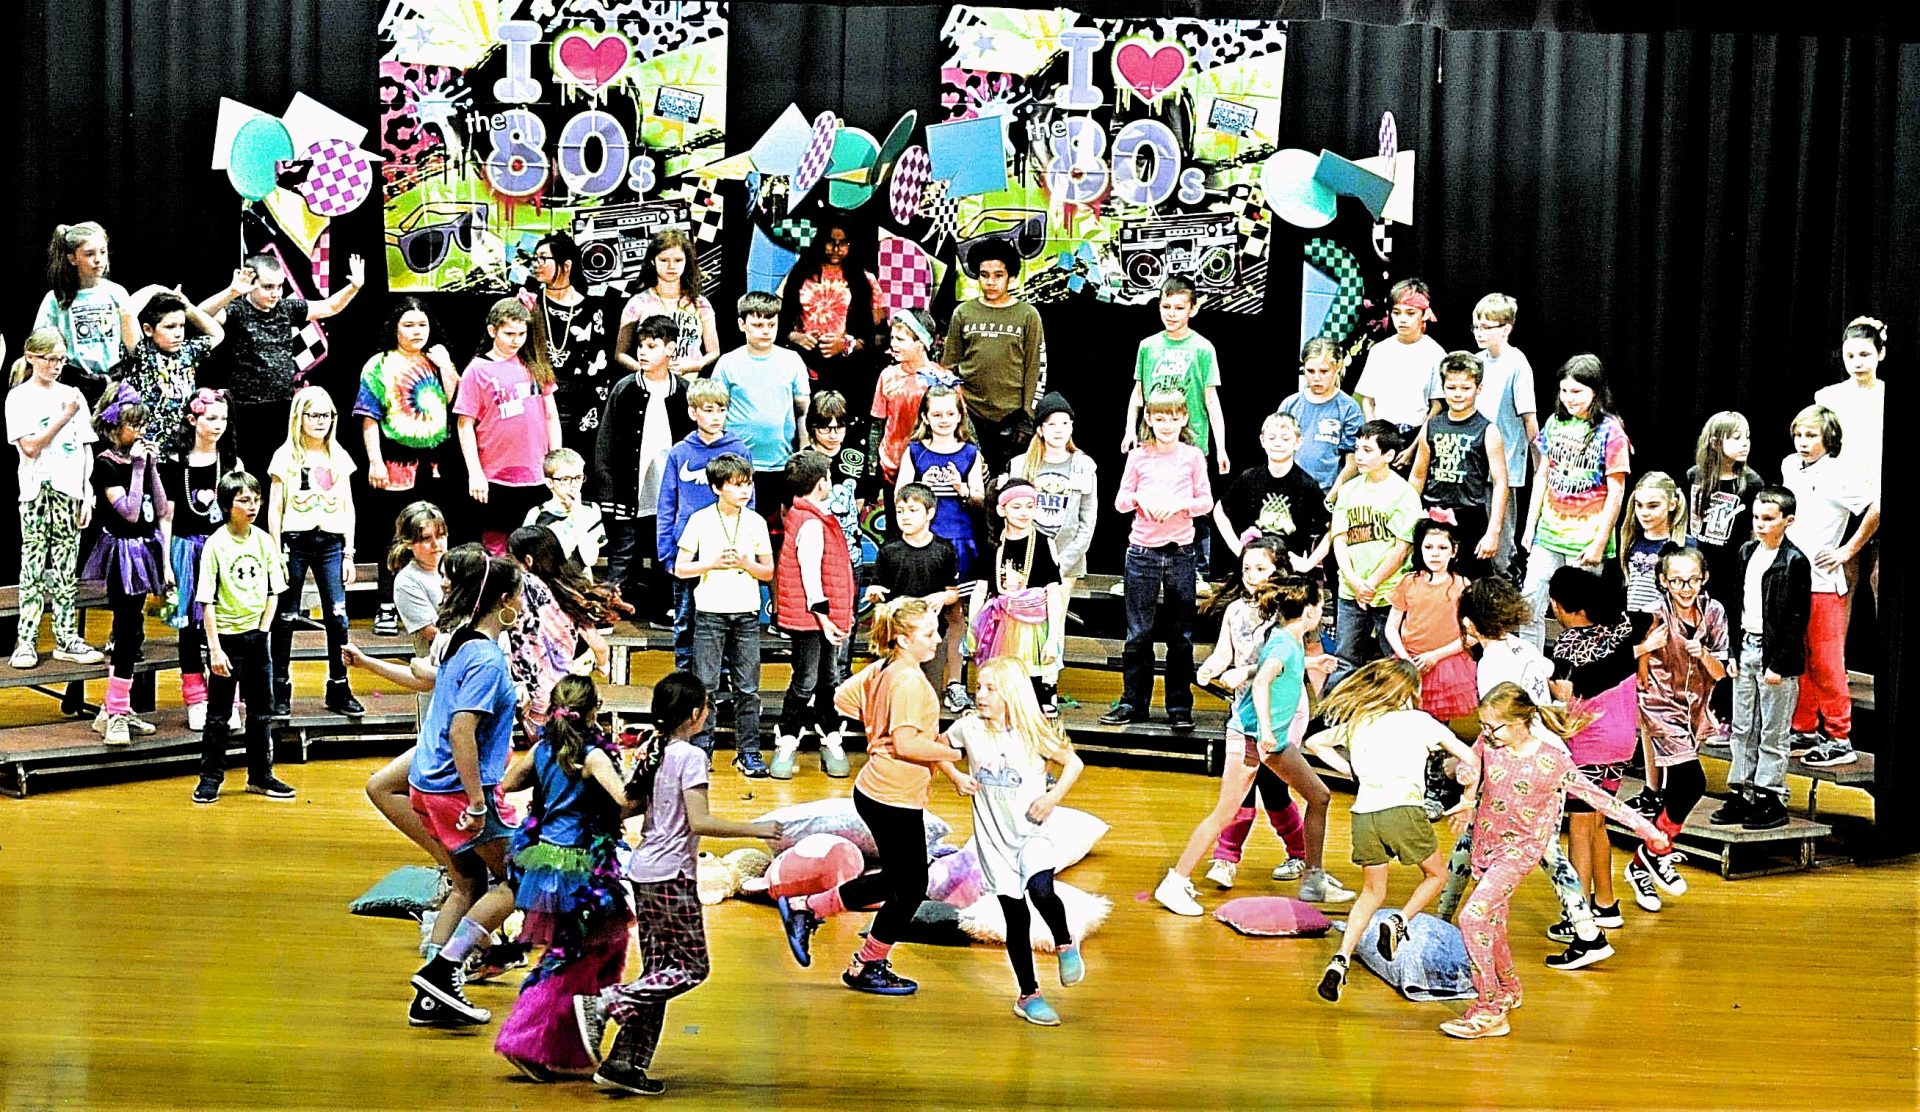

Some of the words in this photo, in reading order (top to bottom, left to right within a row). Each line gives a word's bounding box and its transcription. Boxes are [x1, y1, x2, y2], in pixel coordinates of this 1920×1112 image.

[493, 20, 543, 103] I
[1055, 27, 1105, 110] I
[465, 111, 507, 133] the
[1025, 118, 1067, 142] the
[1440, 456, 1461, 471] MY
[299, 467, 311, 490] I
[1434, 468, 1467, 483] BEST
[1347, 505, 1372, 527] TALLY
